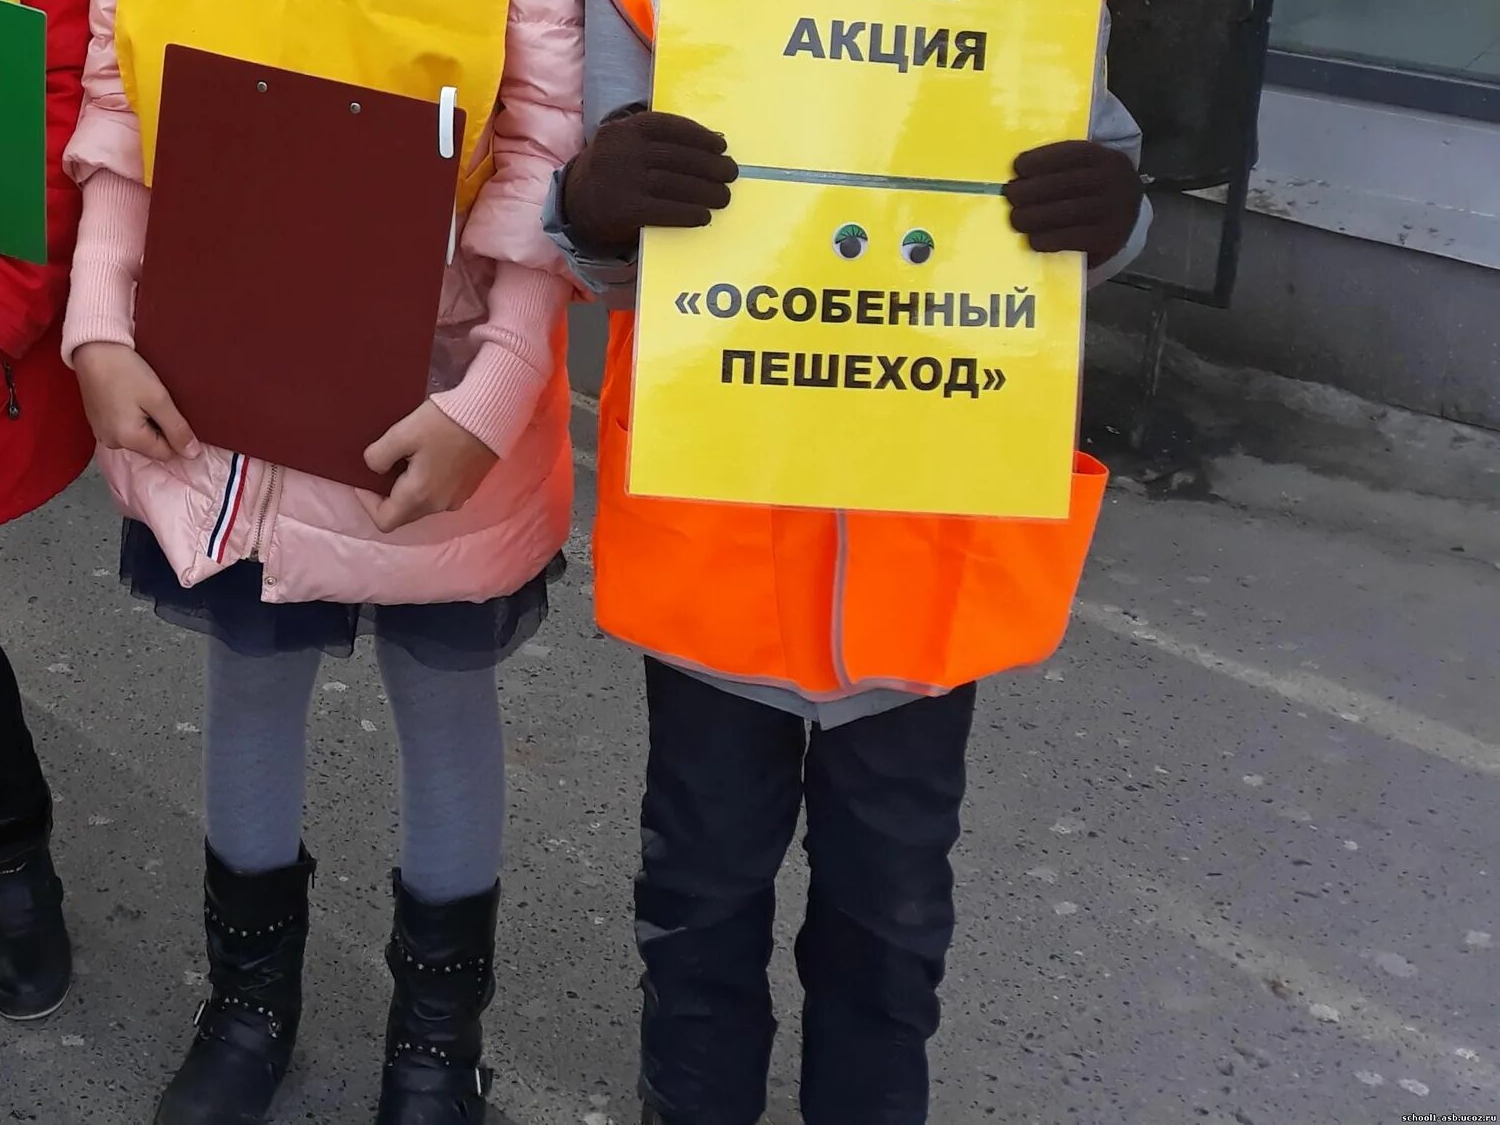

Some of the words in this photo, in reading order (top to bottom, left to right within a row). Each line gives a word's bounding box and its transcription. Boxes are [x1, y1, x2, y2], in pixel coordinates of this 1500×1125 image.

[783, 17, 987, 73] АКЦИЯ
[675, 283, 1035, 328] «ОСОБЕННЫЙ
[721, 349, 1007, 399] ПЕШЕХОД»
